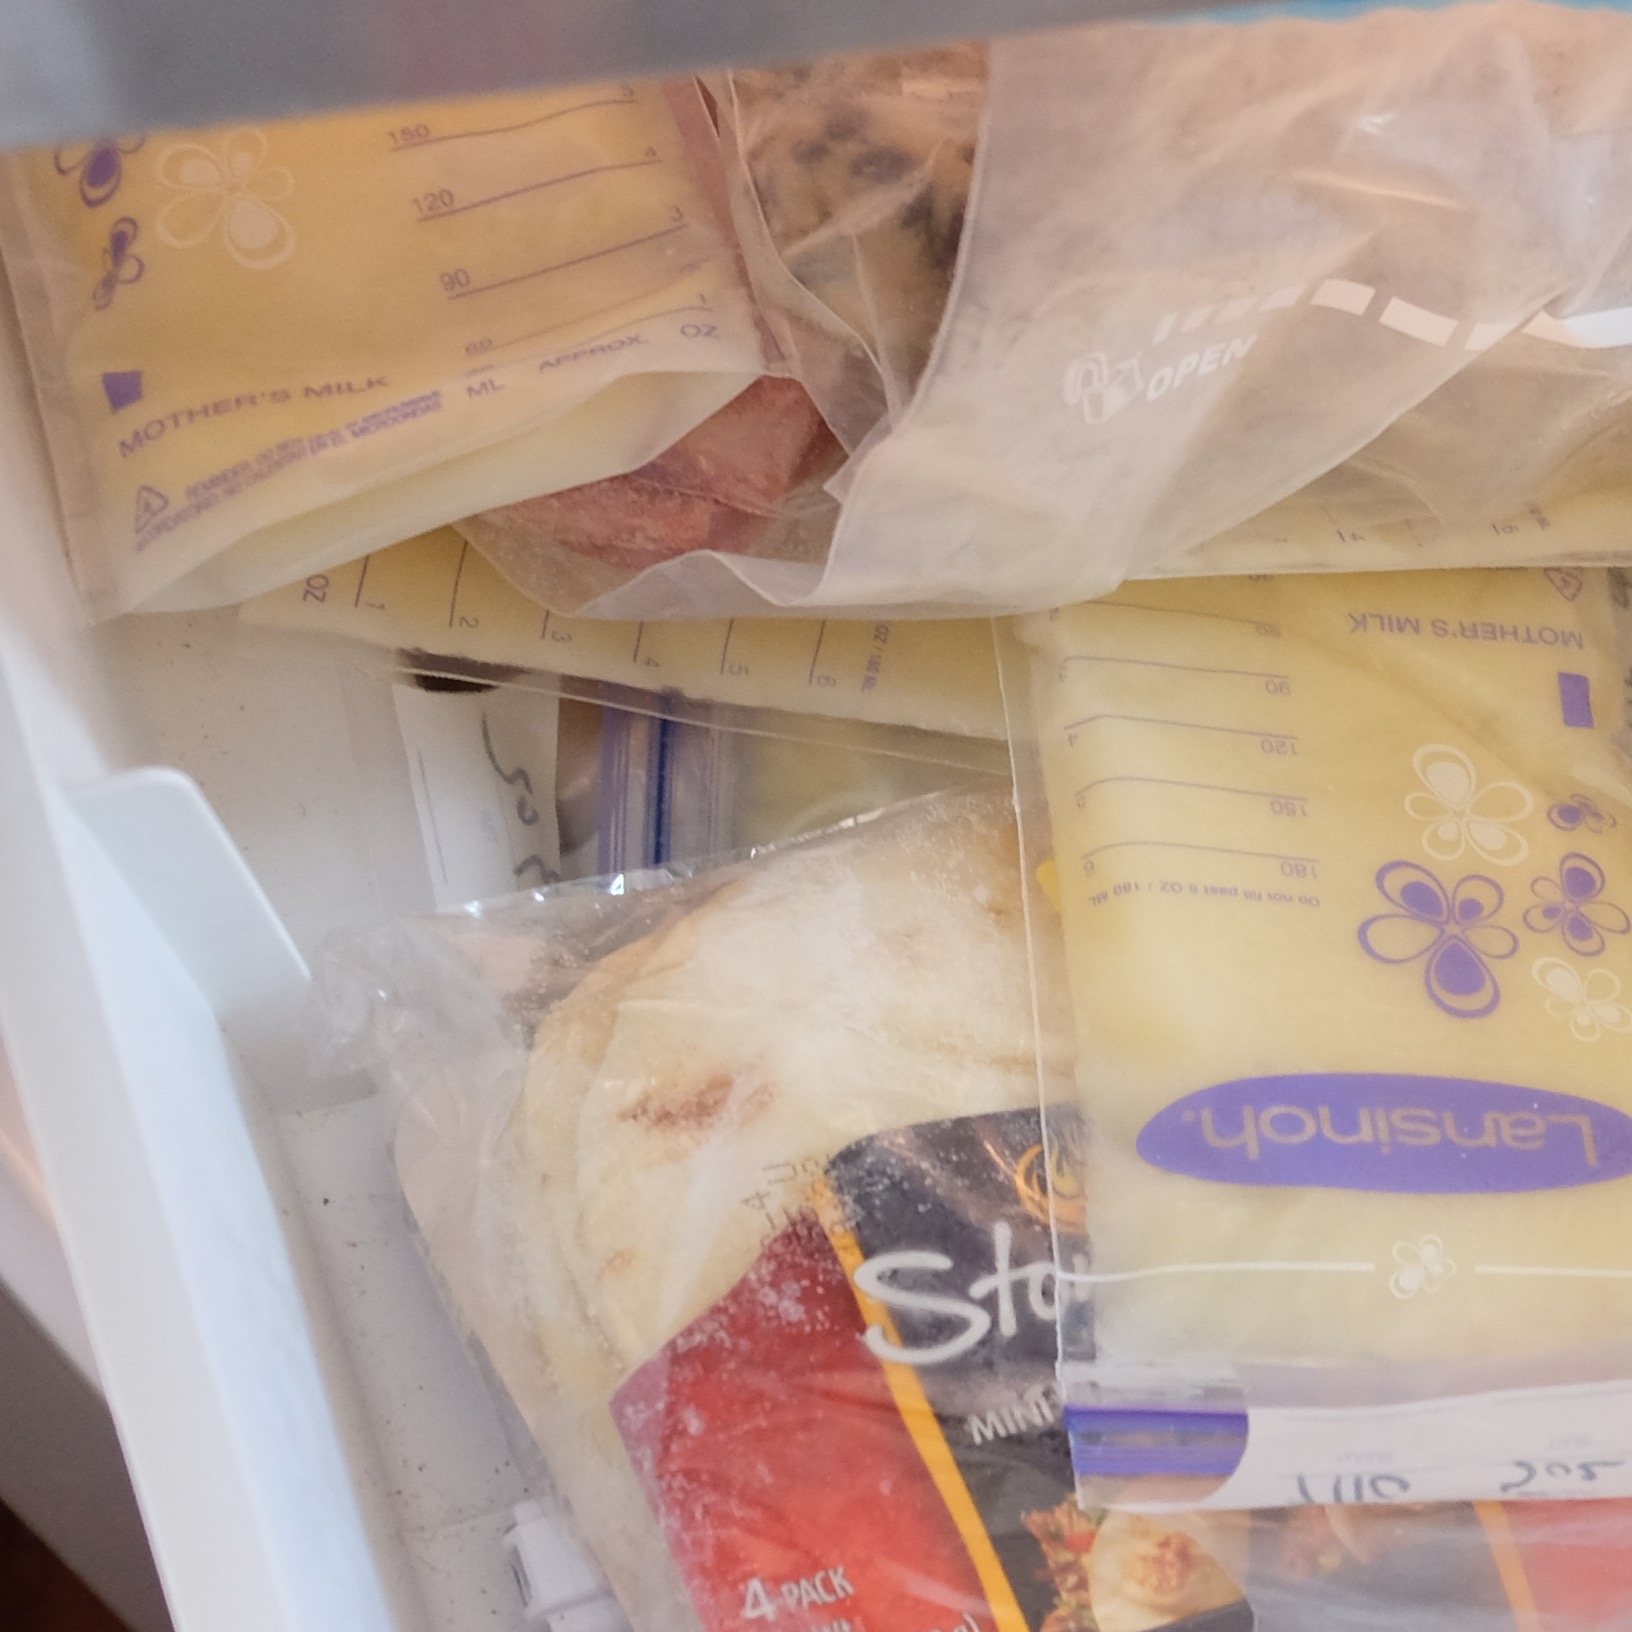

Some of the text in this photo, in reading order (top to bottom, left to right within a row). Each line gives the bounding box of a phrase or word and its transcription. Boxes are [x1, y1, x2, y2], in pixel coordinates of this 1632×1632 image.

[669, 204, 684, 223] 3
[440, 267, 472, 292] 90
[466, 377, 506, 400] ML
[679, 322, 719, 342] OZ
[1144, 335, 1259, 404] OPEN
[117, 376, 390, 459] MOTHER'S MILK
[303, 573, 331, 605] OZ
[458, 615, 481, 631] 2
[1349, 611, 1585, 650] MOTHER'S MILK
[550, 629, 573, 646] 3
[815, 674, 838, 690] 6
[1264, 679, 1293, 697] 90
[1260, 738, 1299, 756] 120
[1269, 799, 1309, 818] 150
[1280, 860, 1320, 879] 180
[1113, 880, 1142, 895] 180
[1159, 880, 1184, 893] OZ
[1188, 1103, 1600, 1168] Lansinoh
